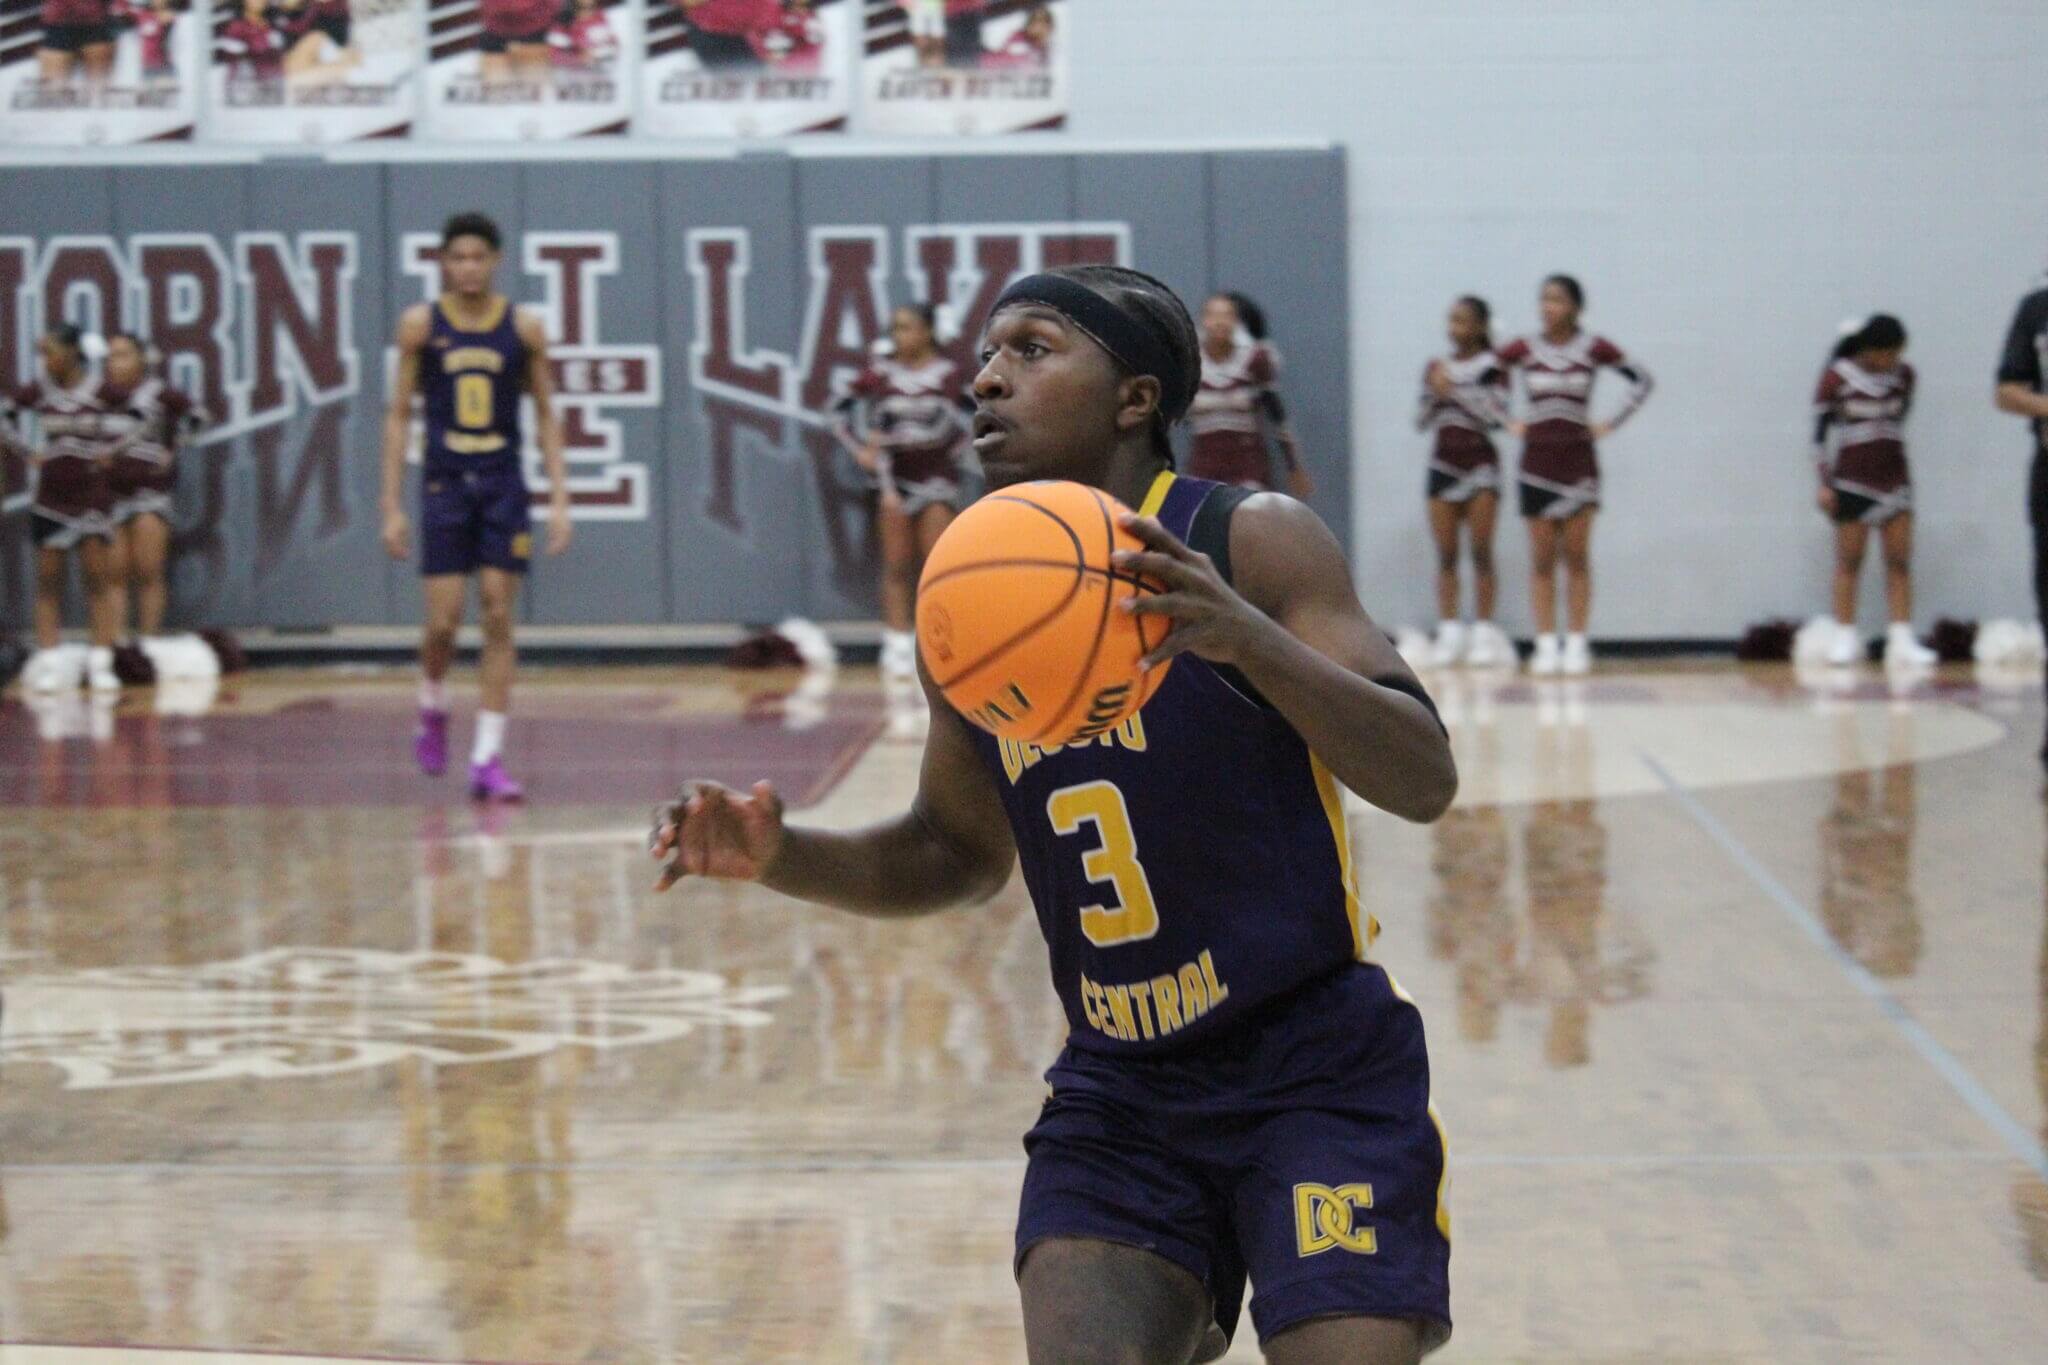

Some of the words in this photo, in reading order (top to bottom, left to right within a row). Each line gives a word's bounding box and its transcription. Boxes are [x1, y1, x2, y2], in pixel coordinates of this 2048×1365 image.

[1046, 780, 1159, 949] 3
[1081, 948, 1229, 1042] CENTRAL
[1293, 1182, 1377, 1258] DC
